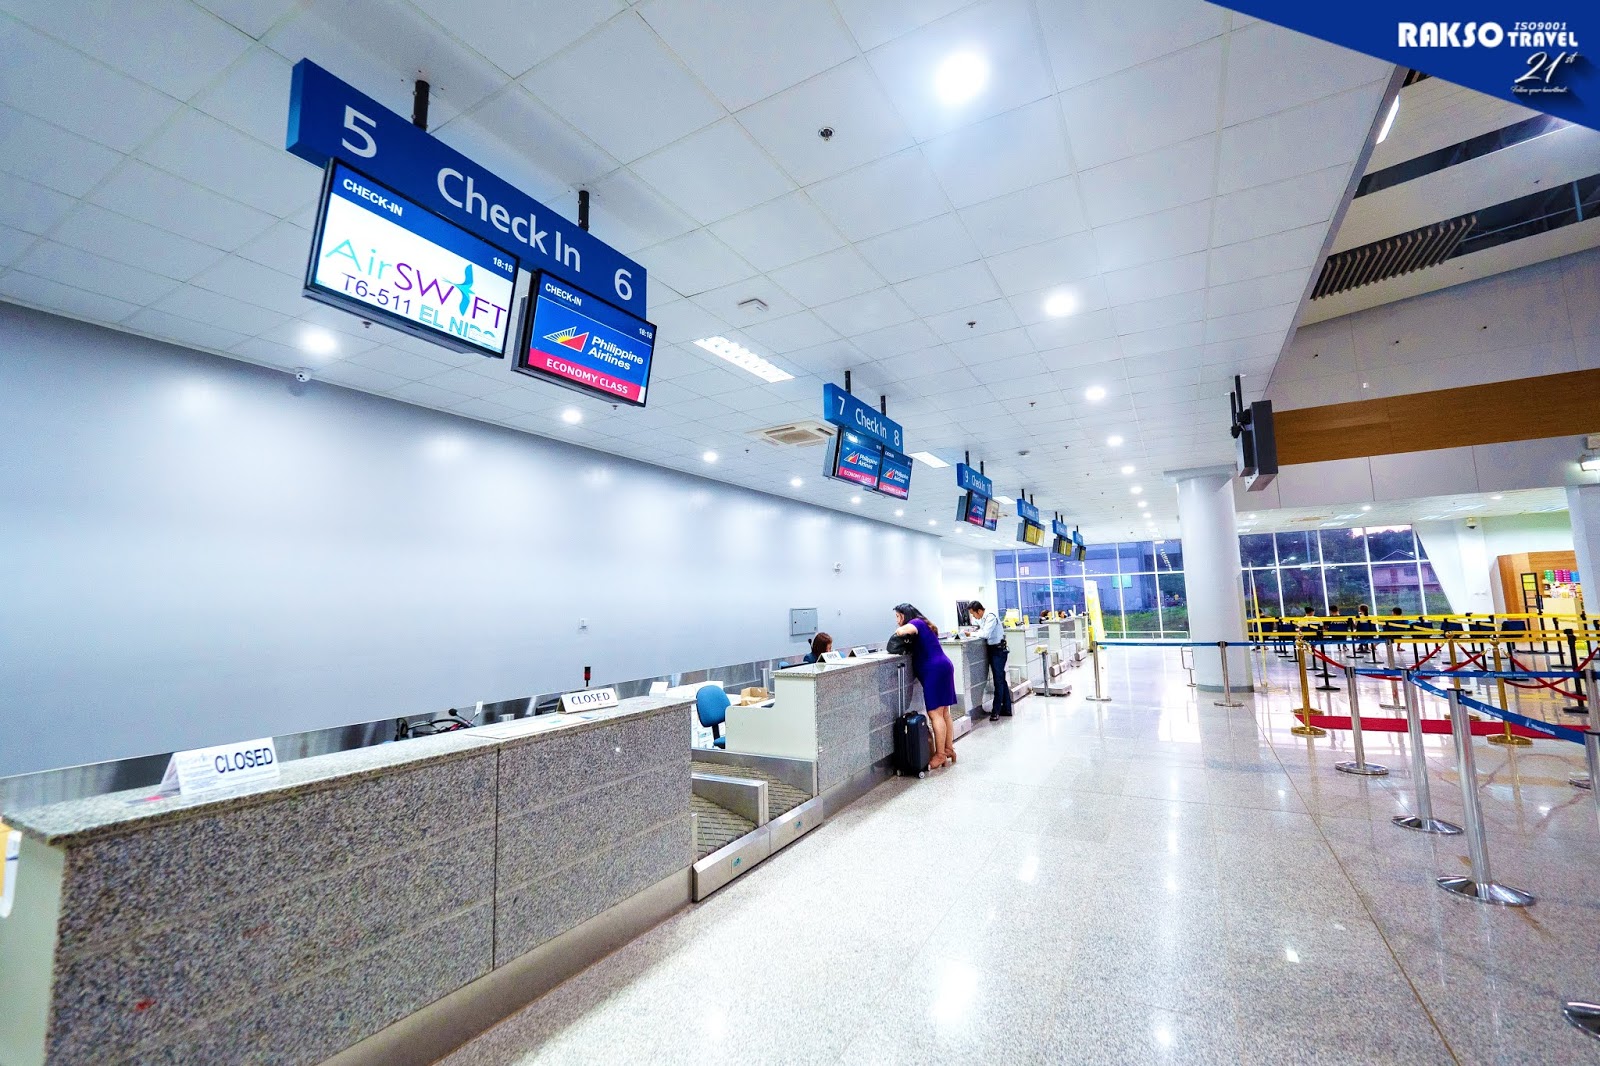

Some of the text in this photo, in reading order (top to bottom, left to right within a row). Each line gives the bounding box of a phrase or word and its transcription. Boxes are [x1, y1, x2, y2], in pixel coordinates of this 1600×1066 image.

[341, 105, 633, 301] 5 Check In 6
[342, 178, 403, 217] CHECK-IN
[492, 256, 514, 274] 18:18
[341, 272, 411, 315] T6-511
[545, 282, 582, 307] CHECK-IN
[419, 304, 444, 329] EL
[588, 347, 631, 370] Airlines
[591, 336, 644, 365] Philippine
[546, 358, 628, 394] ECONOMY CLASS
[838, 396, 845, 416] 7
[855, 407, 879, 435] Check
[879, 422, 887, 440] In
[893, 429, 900, 446] 8
[964, 470, 968, 483] 9
[571, 692, 610, 705] CLOSED
[214, 747, 274, 773] CLOSED
